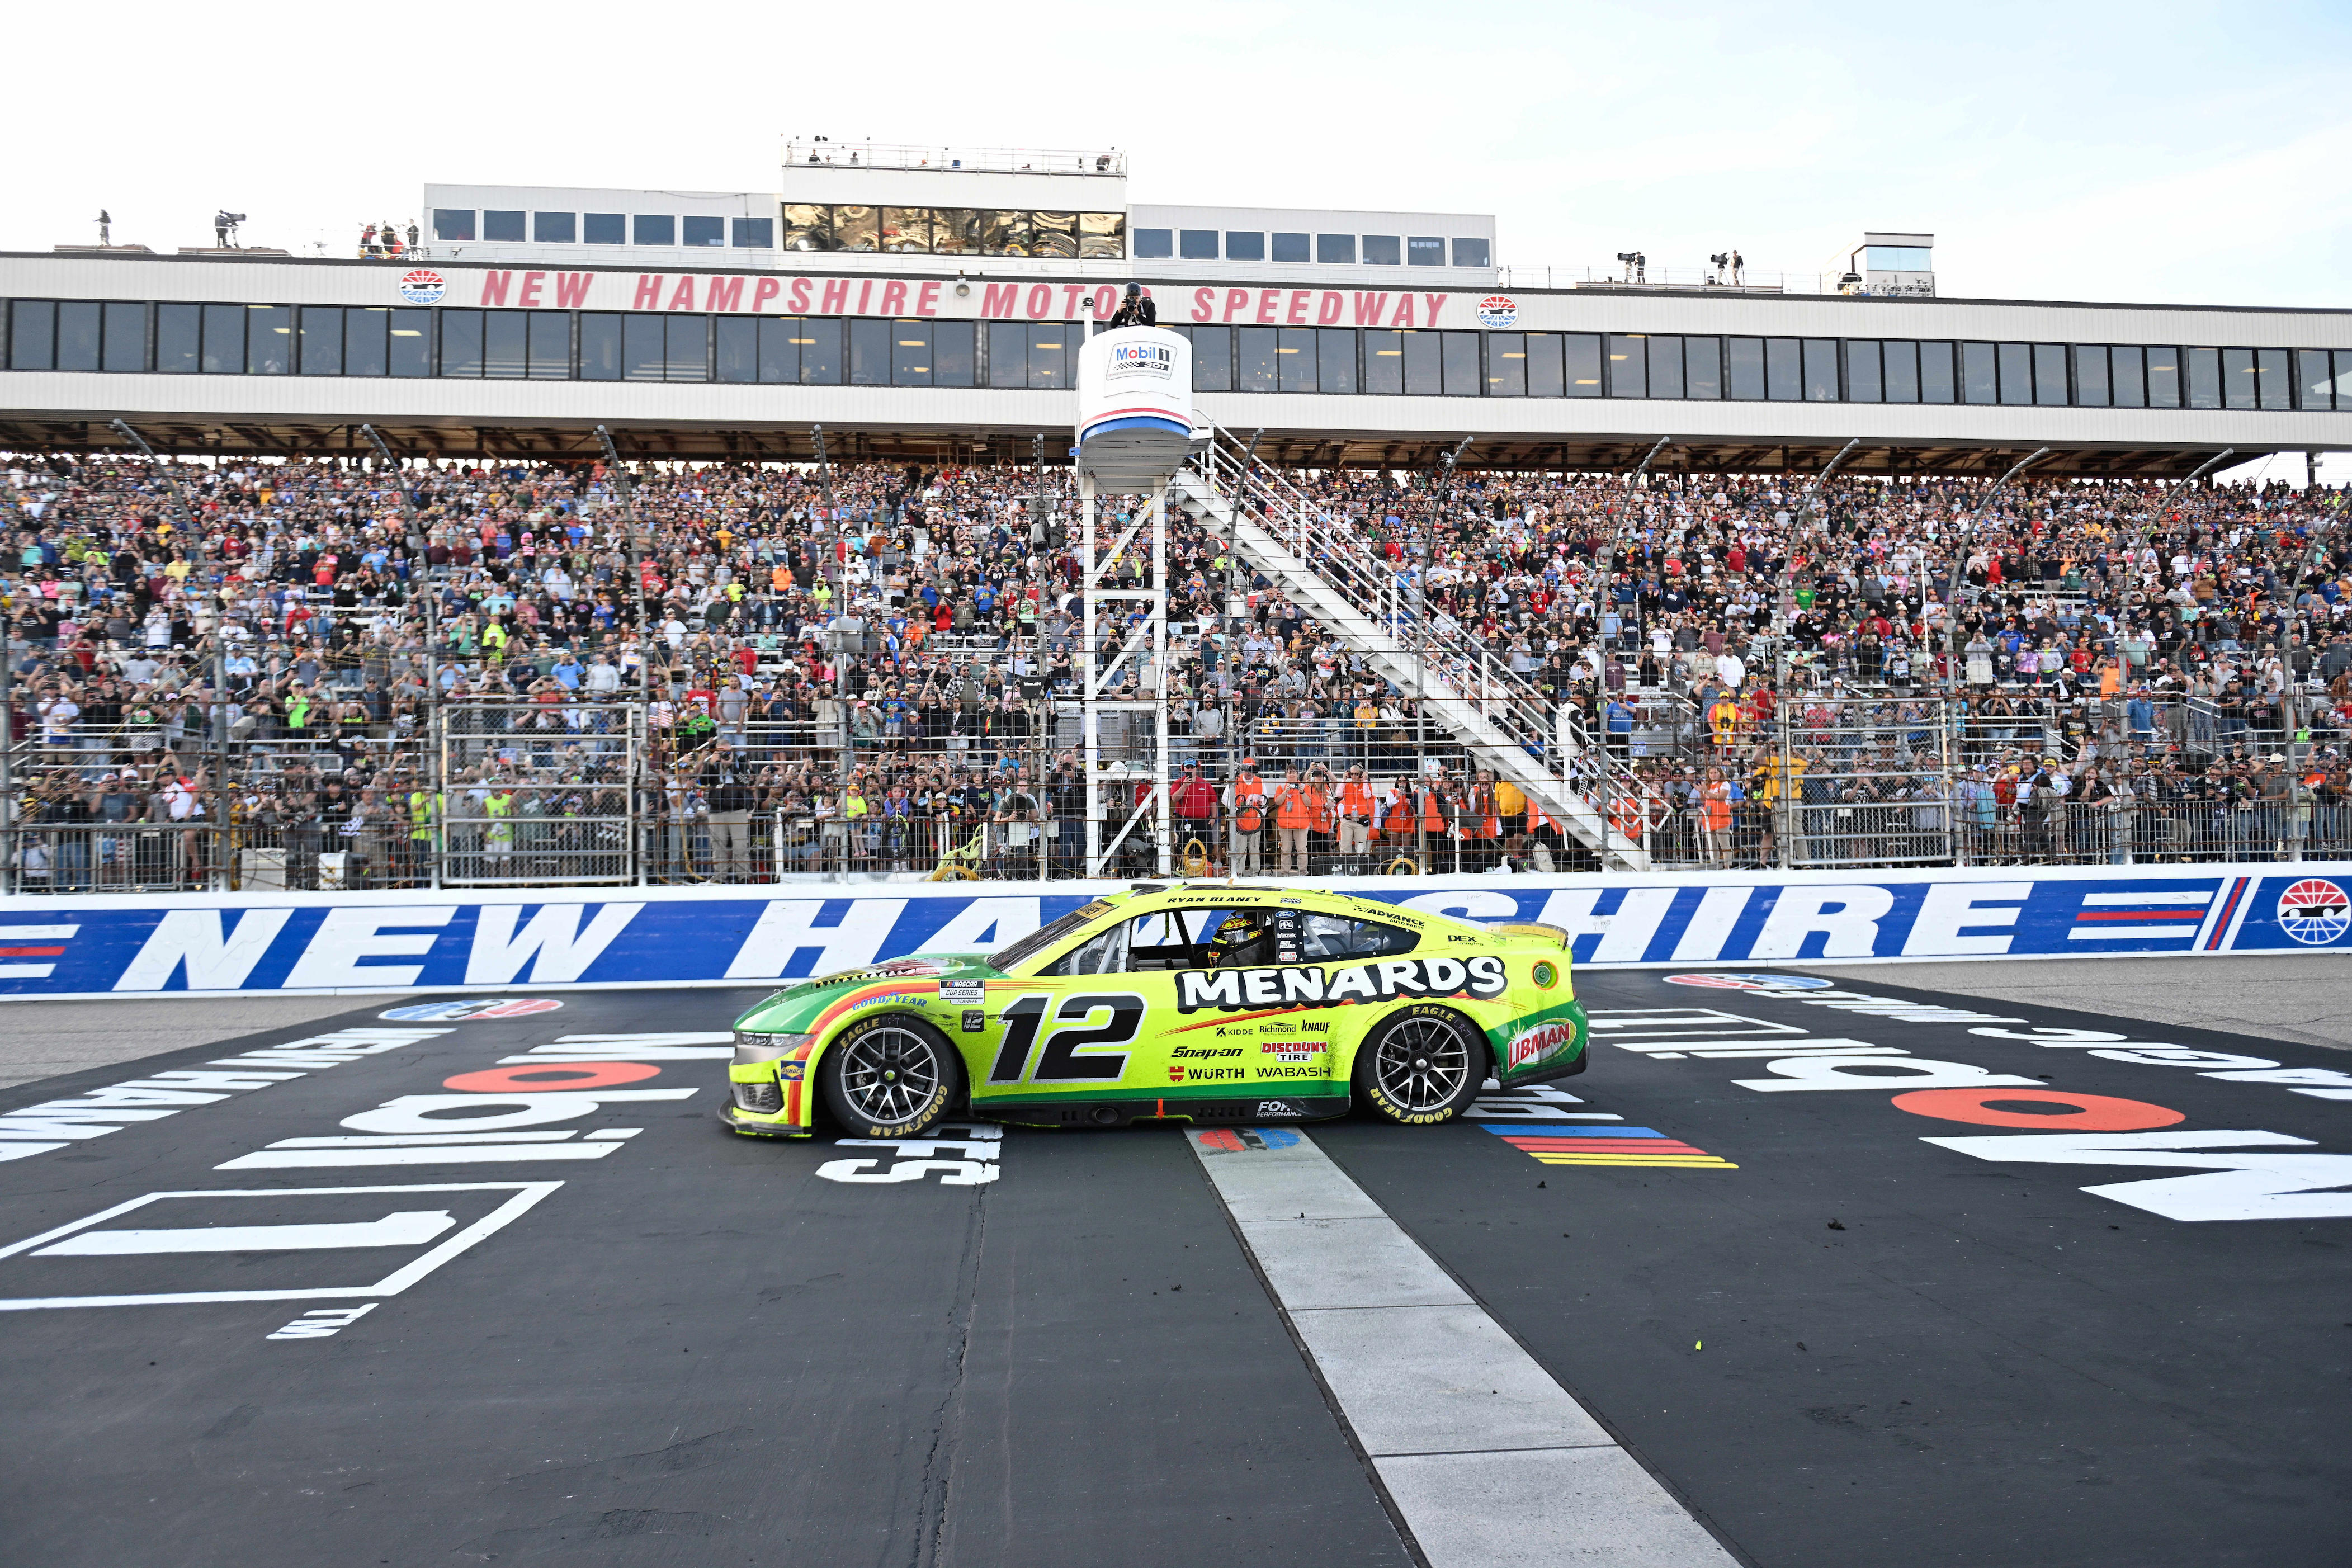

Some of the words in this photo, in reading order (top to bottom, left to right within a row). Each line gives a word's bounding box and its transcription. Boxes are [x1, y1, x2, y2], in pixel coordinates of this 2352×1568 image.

[481, 270, 595, 308] NEW
[633, 273, 942, 317] HAMPSHIRE
[980, 282, 1152, 321] MOTO
[1192, 287, 1448, 327] SPEEDWAY
[1116, 346, 1156, 361] Mobil
[1144, 361, 1165, 370] 301
[1279, 920, 1293, 929] PPG
[1366, 908, 1425, 927] ADVANCE
[1406, 921, 1424, 930] PARTS
[111, 901, 646, 991] NEW
[1177, 956, 1508, 1012] MENARDS
[852, 991, 928, 1011] GOODYEAR
[1411, 1006, 1456, 1022] EAGLE
[840, 1018, 880, 1049] EAGLE
[985, 991, 1149, 1085] 12
[1259, 1024, 1296, 1033] Richmond
[207, 1028, 457, 1069] NEW
[1171, 1046, 1243, 1060] Snap-on
[1261, 1042, 1328, 1054] DISCOUNT
[1508, 1022, 1571, 1073] LIBMAN
[1256, 1066, 1331, 1078] WABASH
[1369, 1087, 1453, 1124] GOODYEAR
[266, 1302, 380, 1340] TM
